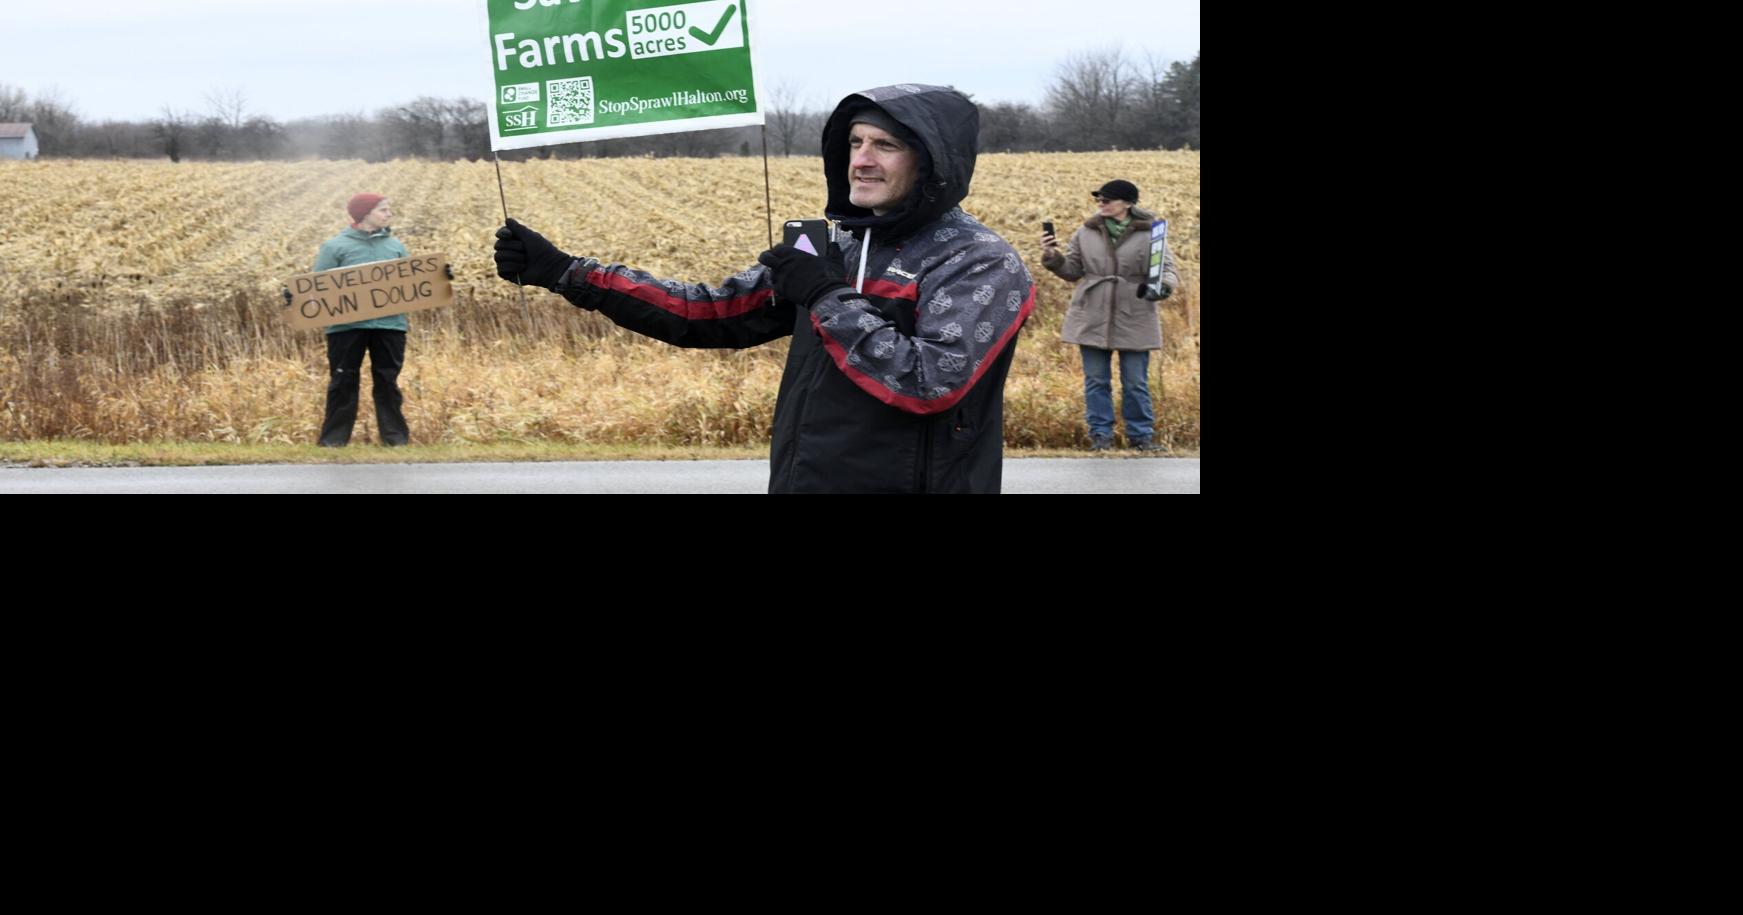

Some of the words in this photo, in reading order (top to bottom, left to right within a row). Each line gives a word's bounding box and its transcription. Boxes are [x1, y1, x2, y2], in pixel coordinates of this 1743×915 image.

[632, 10, 686, 35] 5000
[495, 28, 626, 70] Farms
[633, 36, 686, 55] acres
[598, 89, 748, 115] StopSprawlHalton.org
[295, 257, 439, 294] DEVELOPERS
[300, 292, 359, 319] OWN
[369, 280, 433, 309] DOUG
